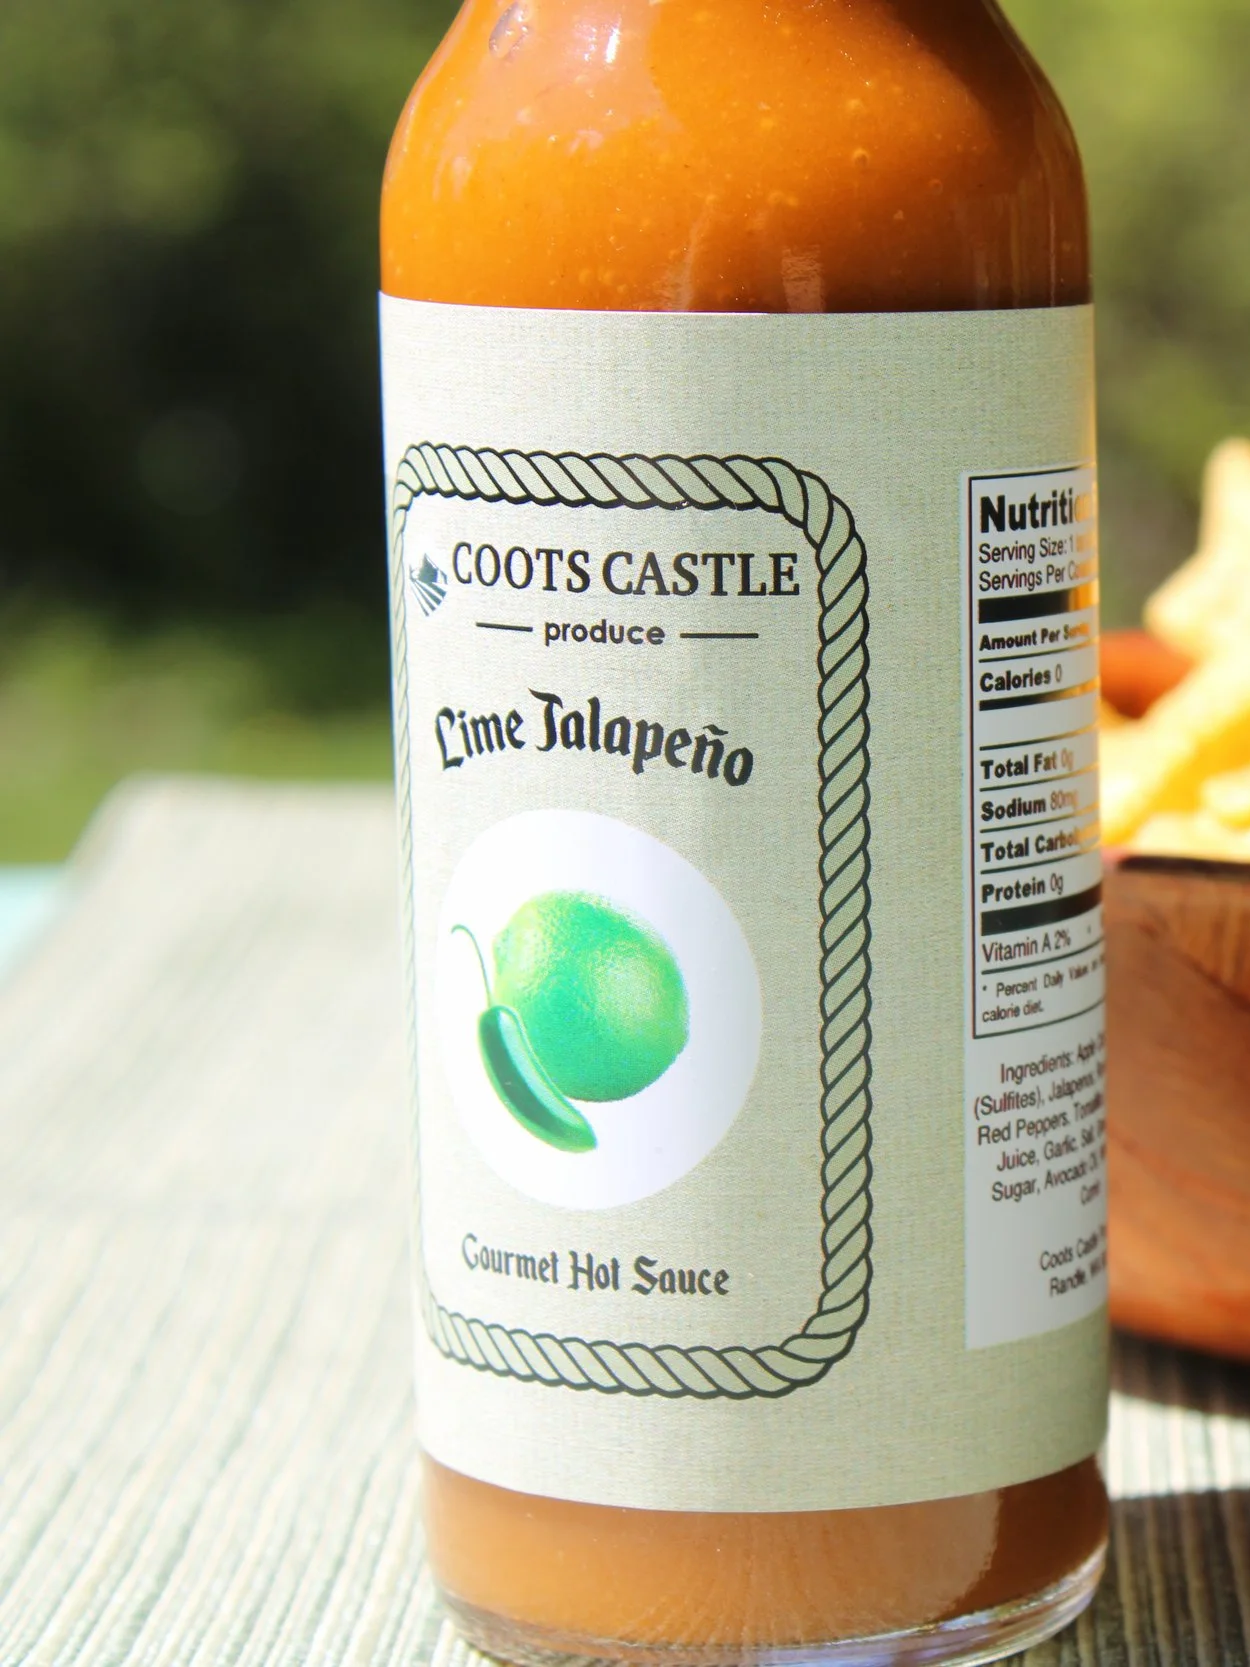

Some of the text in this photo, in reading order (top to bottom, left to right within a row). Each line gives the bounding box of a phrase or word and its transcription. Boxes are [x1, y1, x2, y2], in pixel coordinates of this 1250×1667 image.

[979, 541, 1035, 564] Serving
[1040, 535, 1067, 558] Size:
[453, 542, 800, 597] COOTS CASTLE
[979, 568, 1042, 592] Servings
[1046, 564, 1065, 584] Per
[544, 618, 666, 646] produce
[979, 631, 1037, 651] Amount
[1041, 627, 1060, 644] Per
[979, 667, 1051, 692] Calories
[435, 688, 754, 787] Lime Jalapeño
[980, 755, 1029, 780] Total
[1034, 752, 1057, 773] Fat
[981, 796, 1046, 821] Sodium
[980, 837, 1029, 863] Total
[981, 873, 1064, 903] Protein 0g
[982, 938, 1039, 963] Vitamin
[1041, 932, 1051, 952] A
[996, 975, 1038, 998] Percent
[982, 1003, 1020, 1023] calorie
[1000, 1052, 1074, 1085] Ingredients:
[978, 1123, 1011, 1145] Red
[997, 1147, 1040, 1172] Juice,
[992, 1177, 1040, 1203] Sugar,
[461, 1232, 730, 1296] Gourmet Hot Sauce
[1040, 1244, 1074, 1271] Coots
